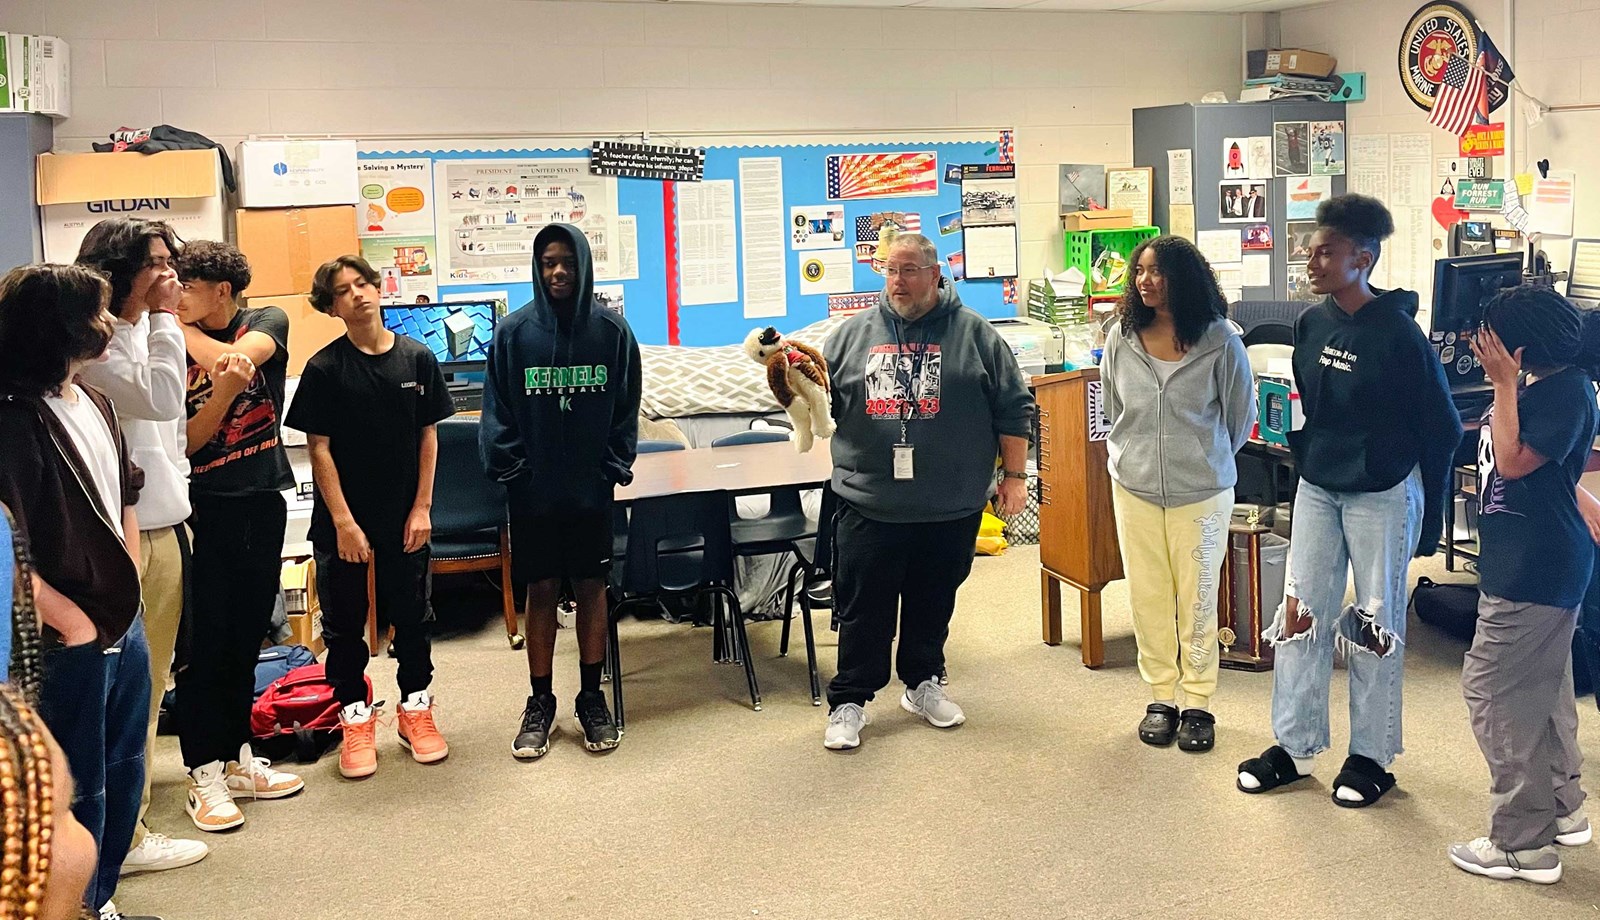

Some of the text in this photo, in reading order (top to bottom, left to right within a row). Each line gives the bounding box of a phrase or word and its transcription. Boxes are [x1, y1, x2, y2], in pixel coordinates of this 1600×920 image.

[1410, 18, 1470, 58] UNITED STATES
[1410, 65, 1435, 96] MARINE
[609, 151, 631, 160] teacher
[631, 153, 649, 161] affects
[675, 155, 683, 164] he
[396, 163, 424, 171] Mystery
[1468, 167, 1485, 177] EVER
[1462, 189, 1498, 198] FORREST
[87, 198, 170, 213] GILDAN
[1318, 354, 1332, 367] Rap
[524, 364, 608, 389] KERNELS
[526, 385, 606, 396] BASEBALL
[243, 445, 260, 457] OFF
[1248, 509, 1259, 518] 13
[1189, 602, 1213, 664] Beach
